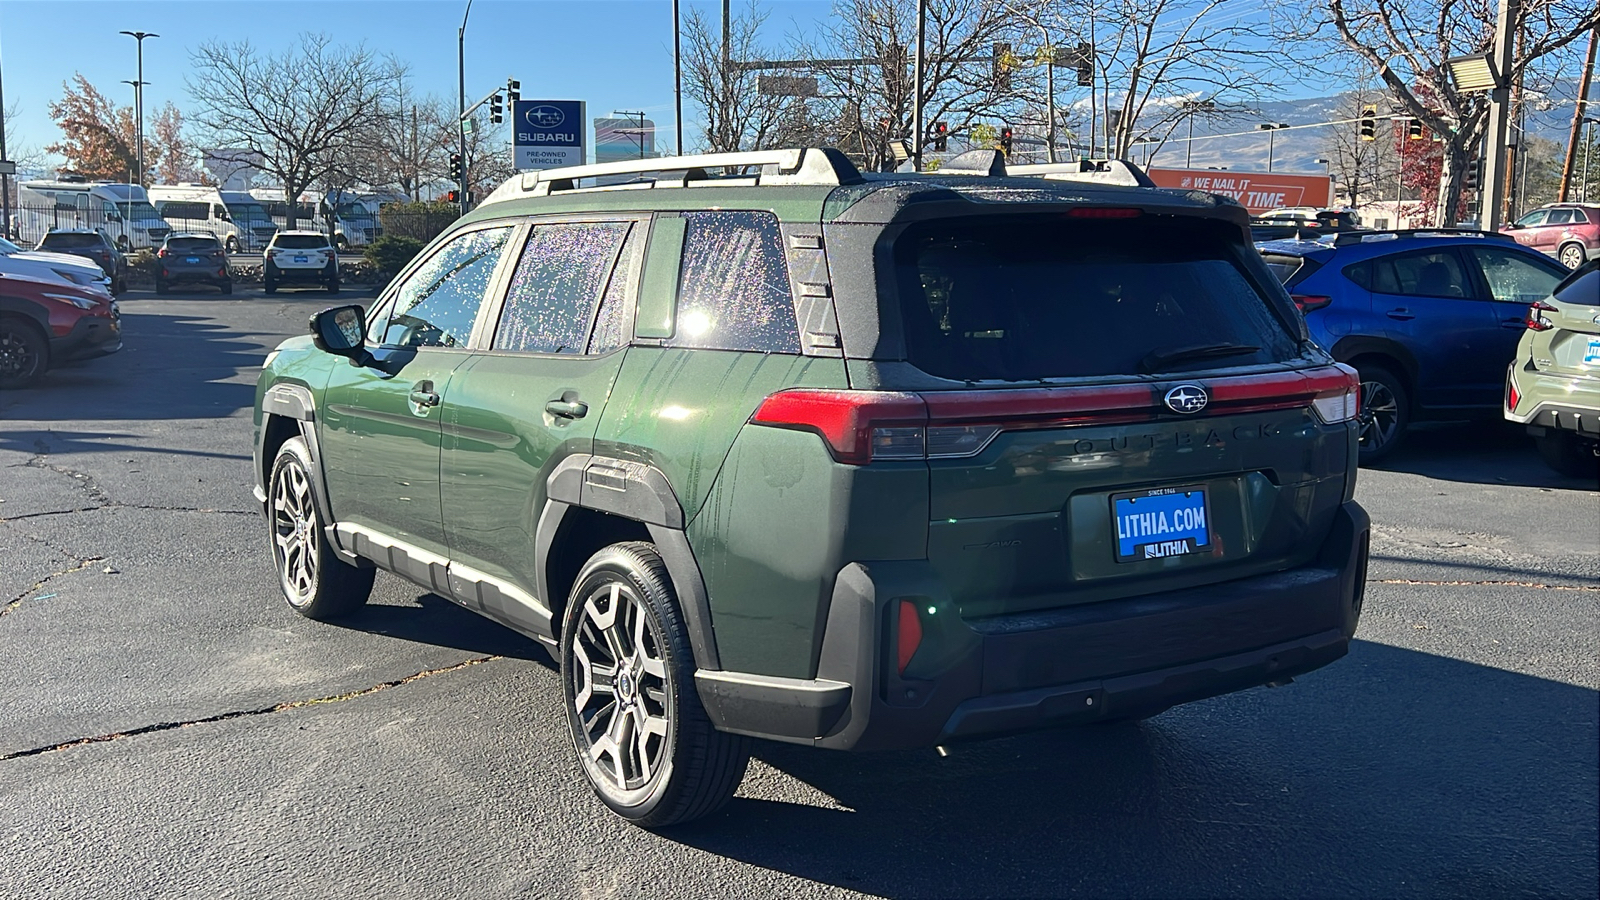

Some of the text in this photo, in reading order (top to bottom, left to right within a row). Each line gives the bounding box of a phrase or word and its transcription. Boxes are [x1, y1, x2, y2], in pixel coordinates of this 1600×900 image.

[518, 132, 575, 142] SUBARU
[1194, 177, 1251, 191] WE NAIL IT
[1246, 191, 1287, 209] TIME.
[1073, 423, 1272, 455] OUTBACK
[1117, 506, 1206, 539] LITHIA.COM
[1155, 540, 1190, 557] LITHIA
